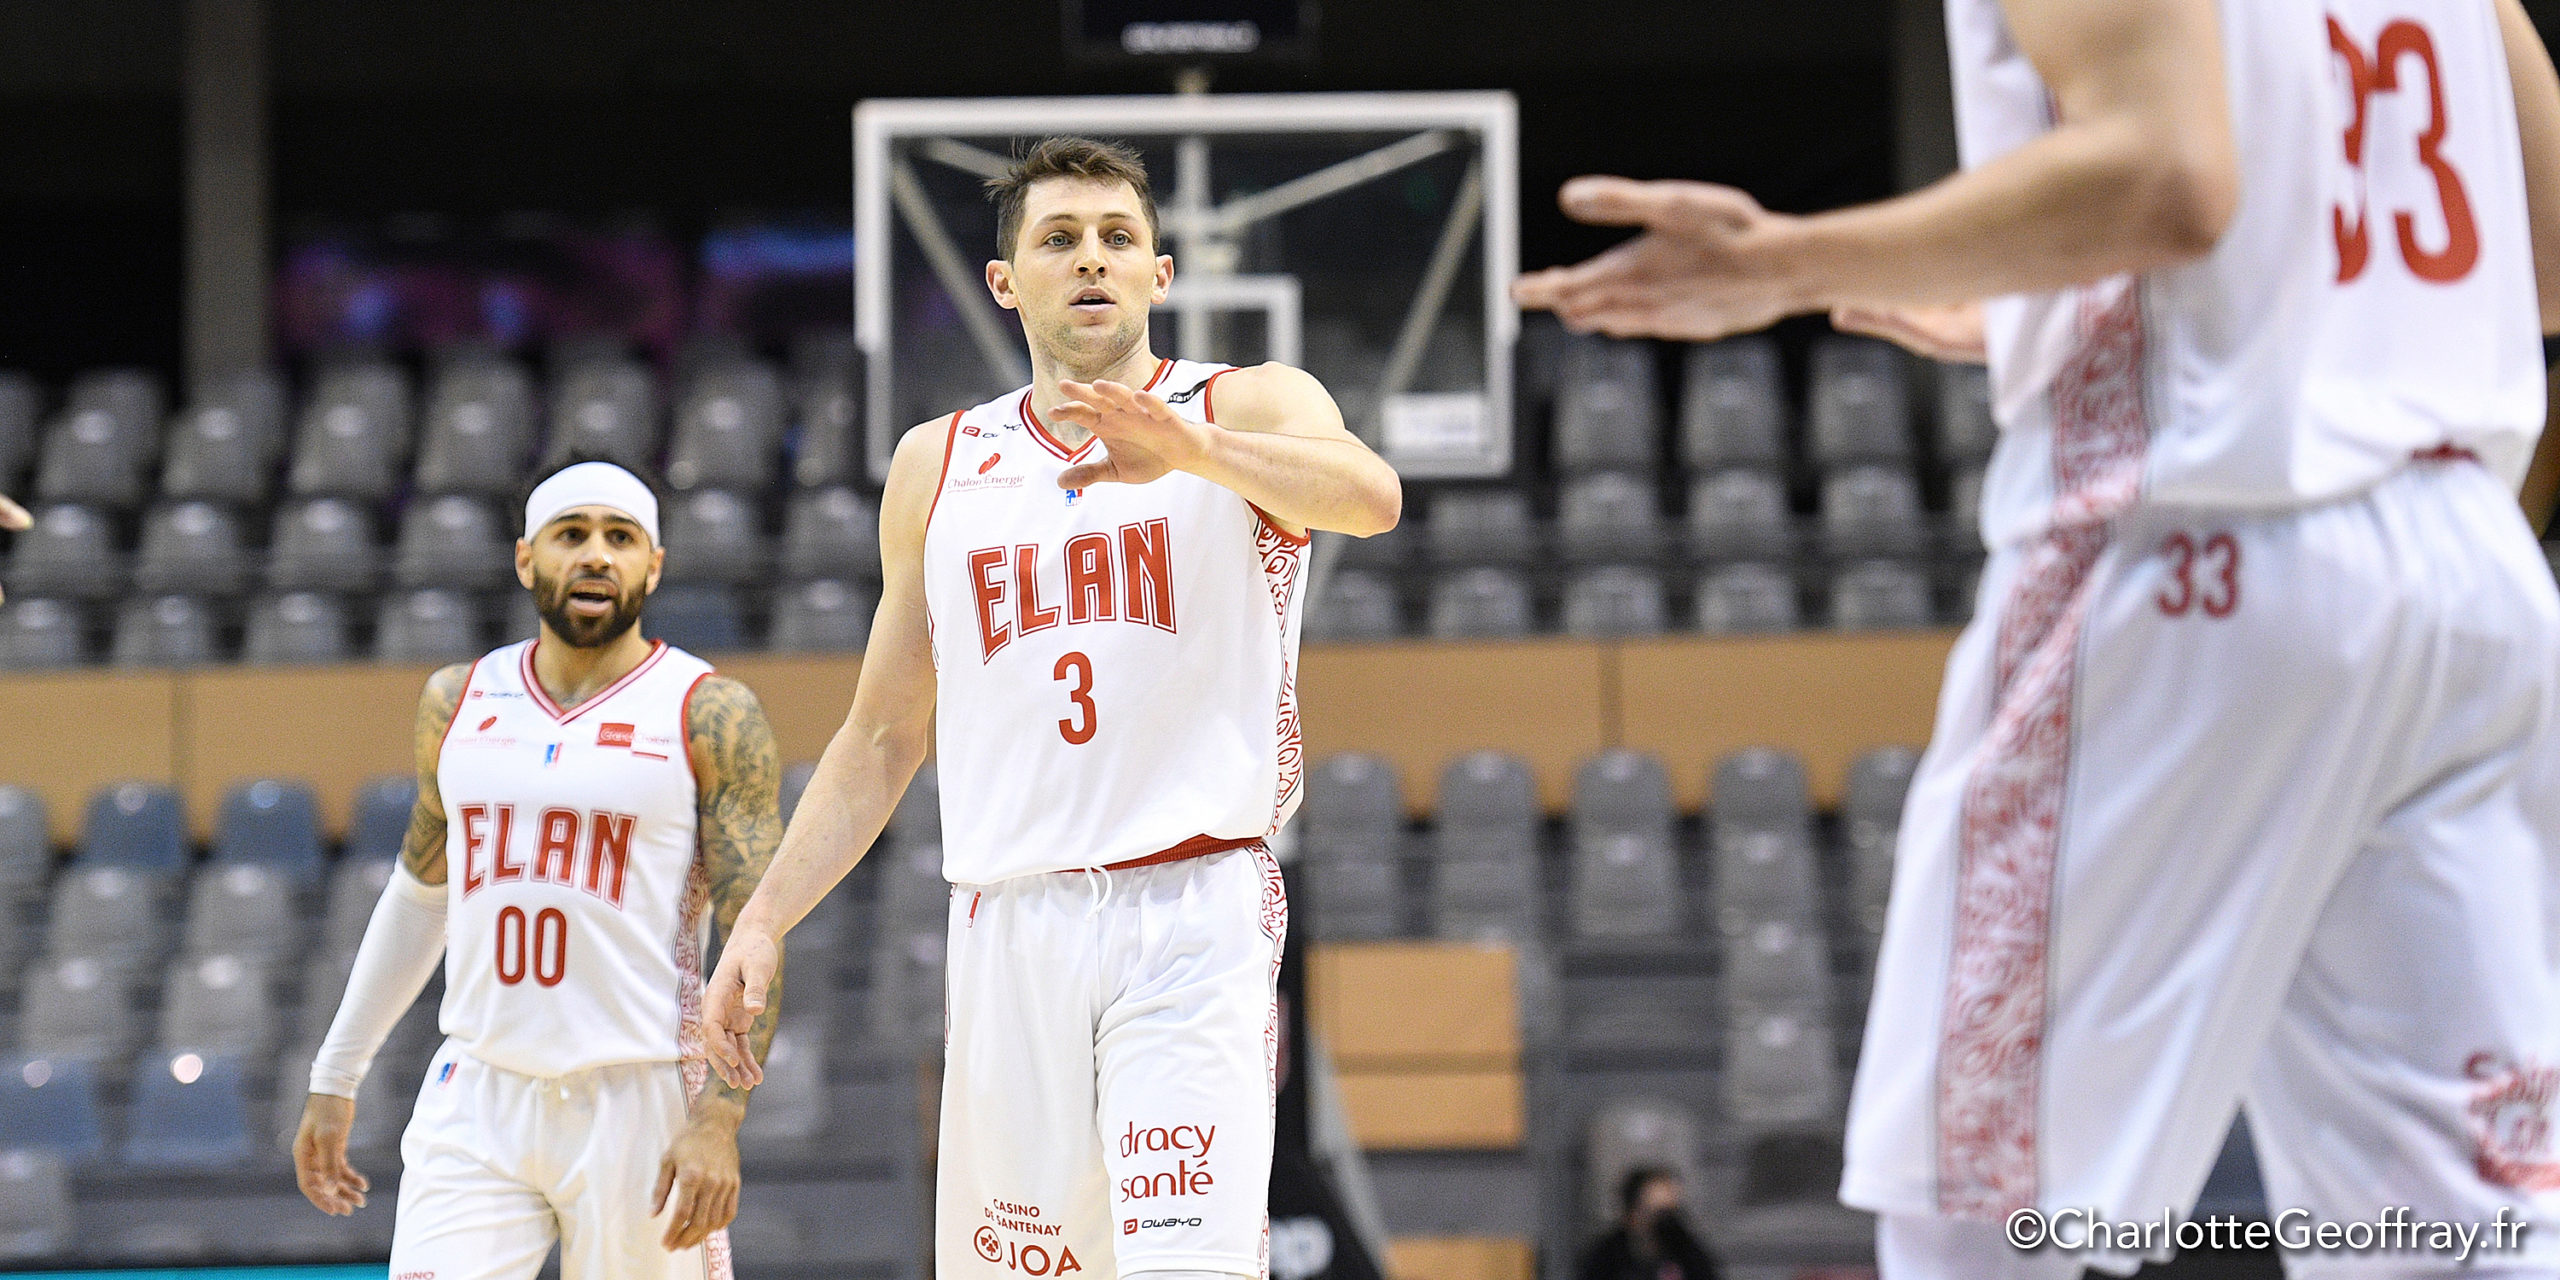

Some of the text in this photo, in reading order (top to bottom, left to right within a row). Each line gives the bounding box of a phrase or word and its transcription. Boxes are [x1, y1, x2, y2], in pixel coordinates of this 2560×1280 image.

[947, 477, 982, 489] Chalon
[967, 517, 1177, 665] ELAN
[2154, 531, 2240, 620] 33
[1053, 651, 1098, 745] 3
[458, 803, 637, 911] ELAN
[494, 905, 567, 988] 00
[1120, 1121, 1215, 1158] dracy
[1121, 1160, 1214, 1203] santé
[984, 1207, 1062, 1236] DE SANTENAY
[993, 1198, 1040, 1218] CASINO
[1007, 1241, 1082, 1277] JOA
